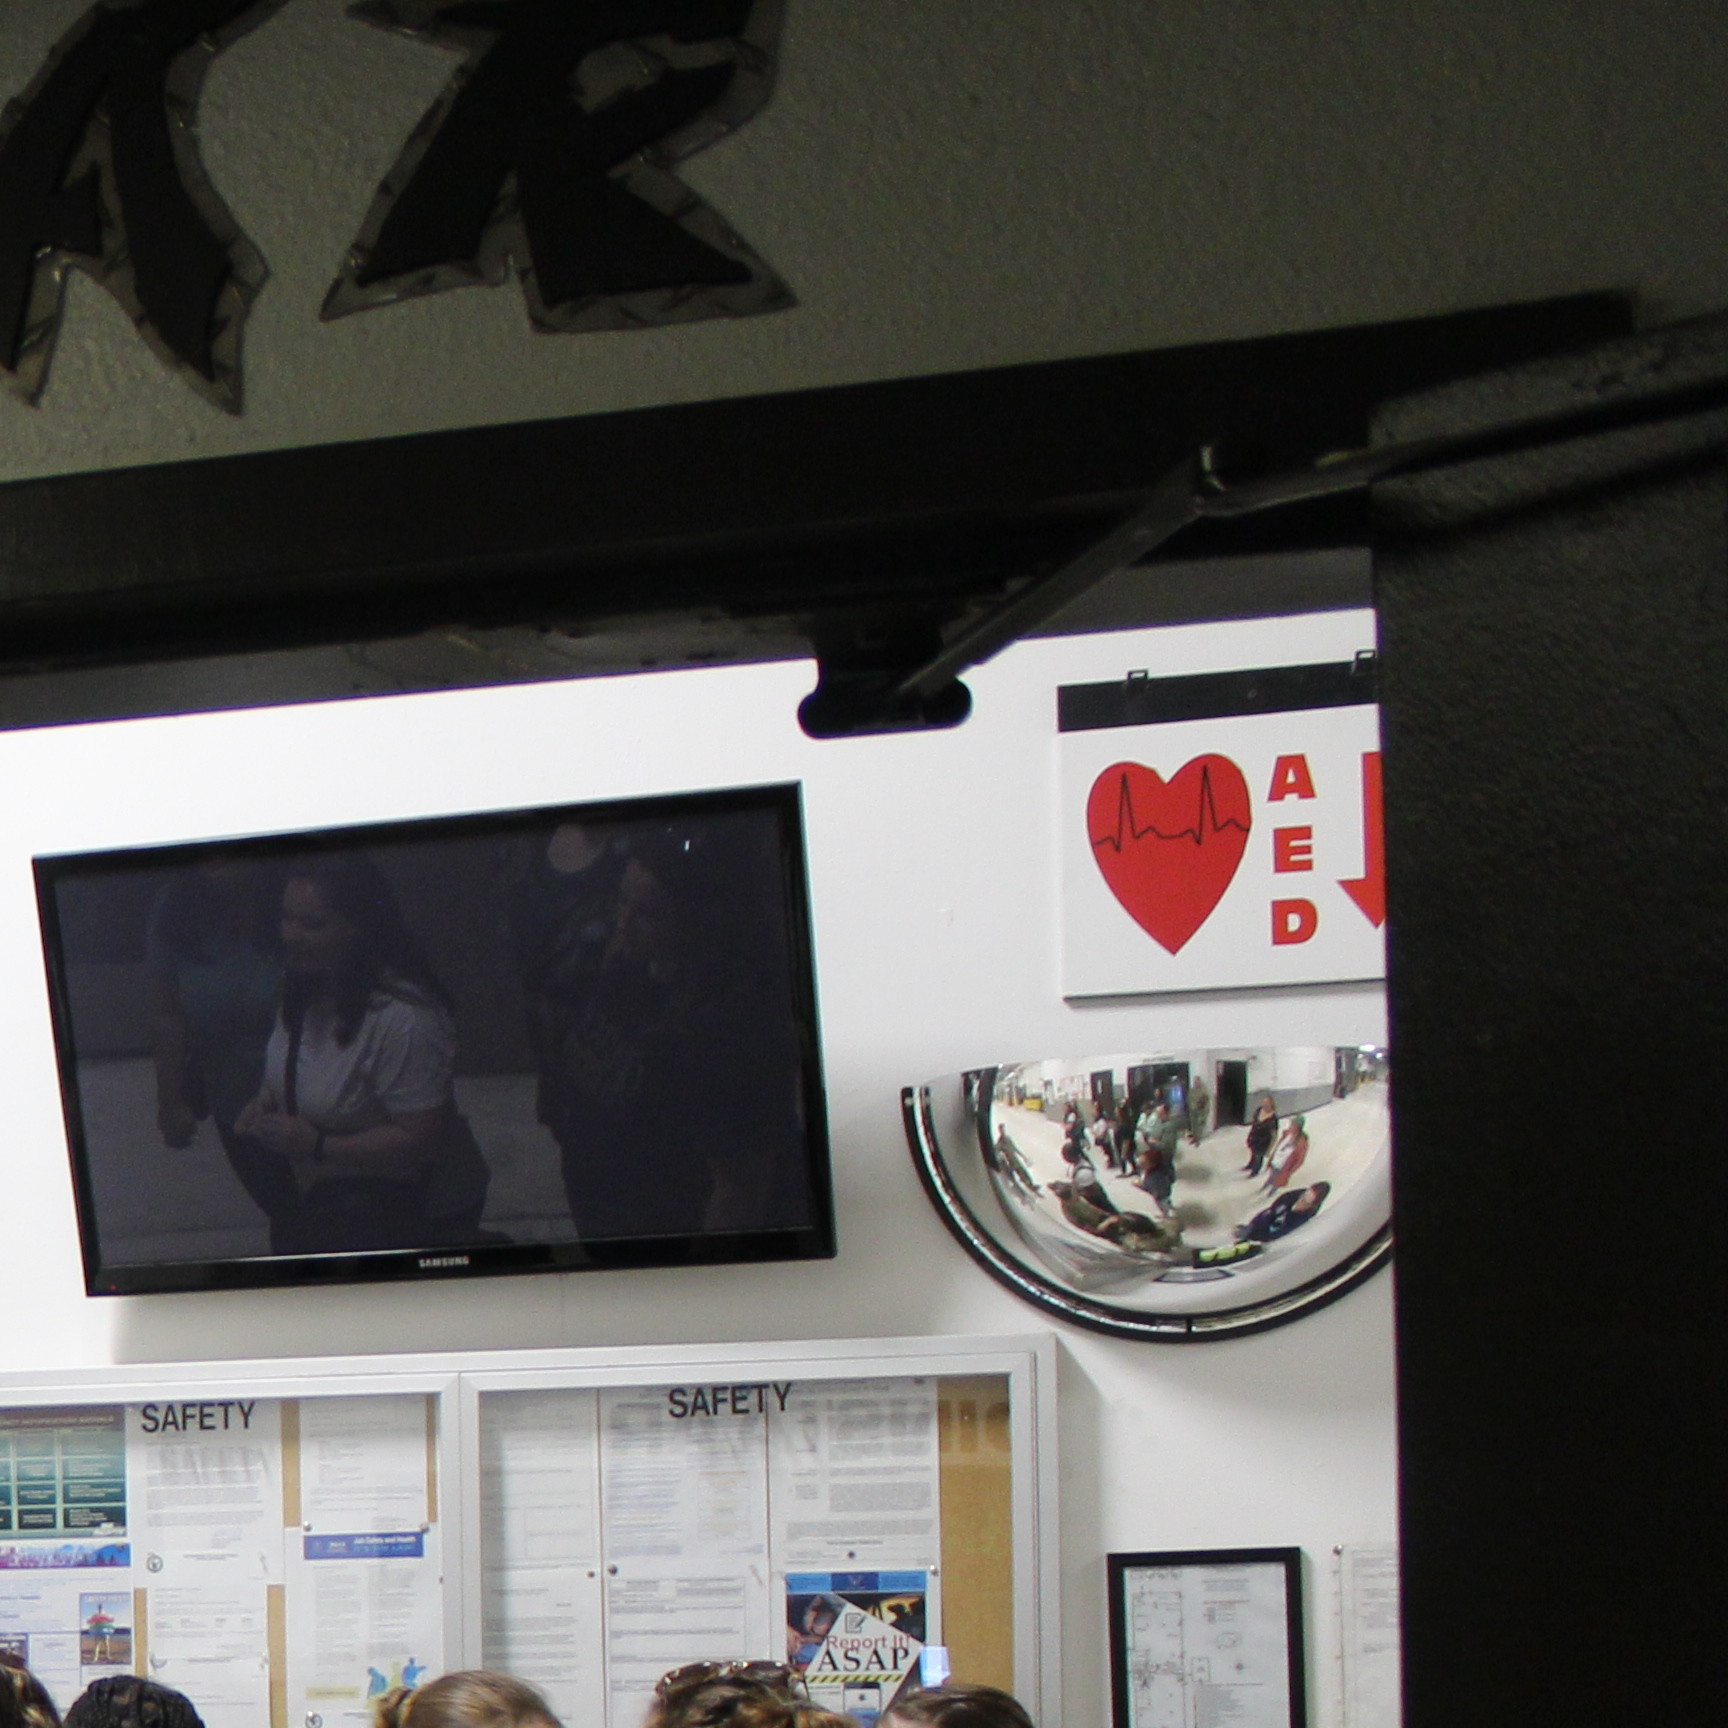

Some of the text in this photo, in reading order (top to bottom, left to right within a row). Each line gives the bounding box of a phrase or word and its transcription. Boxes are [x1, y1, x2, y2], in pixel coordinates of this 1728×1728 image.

[419, 1256, 469, 1268] SAMSUNG
[668, 1382, 793, 1419] SAFETY
[141, 1401, 256, 1433] SAFETY
[827, 1635, 887, 1653] Report
[818, 1648, 910, 1672] ASAP
